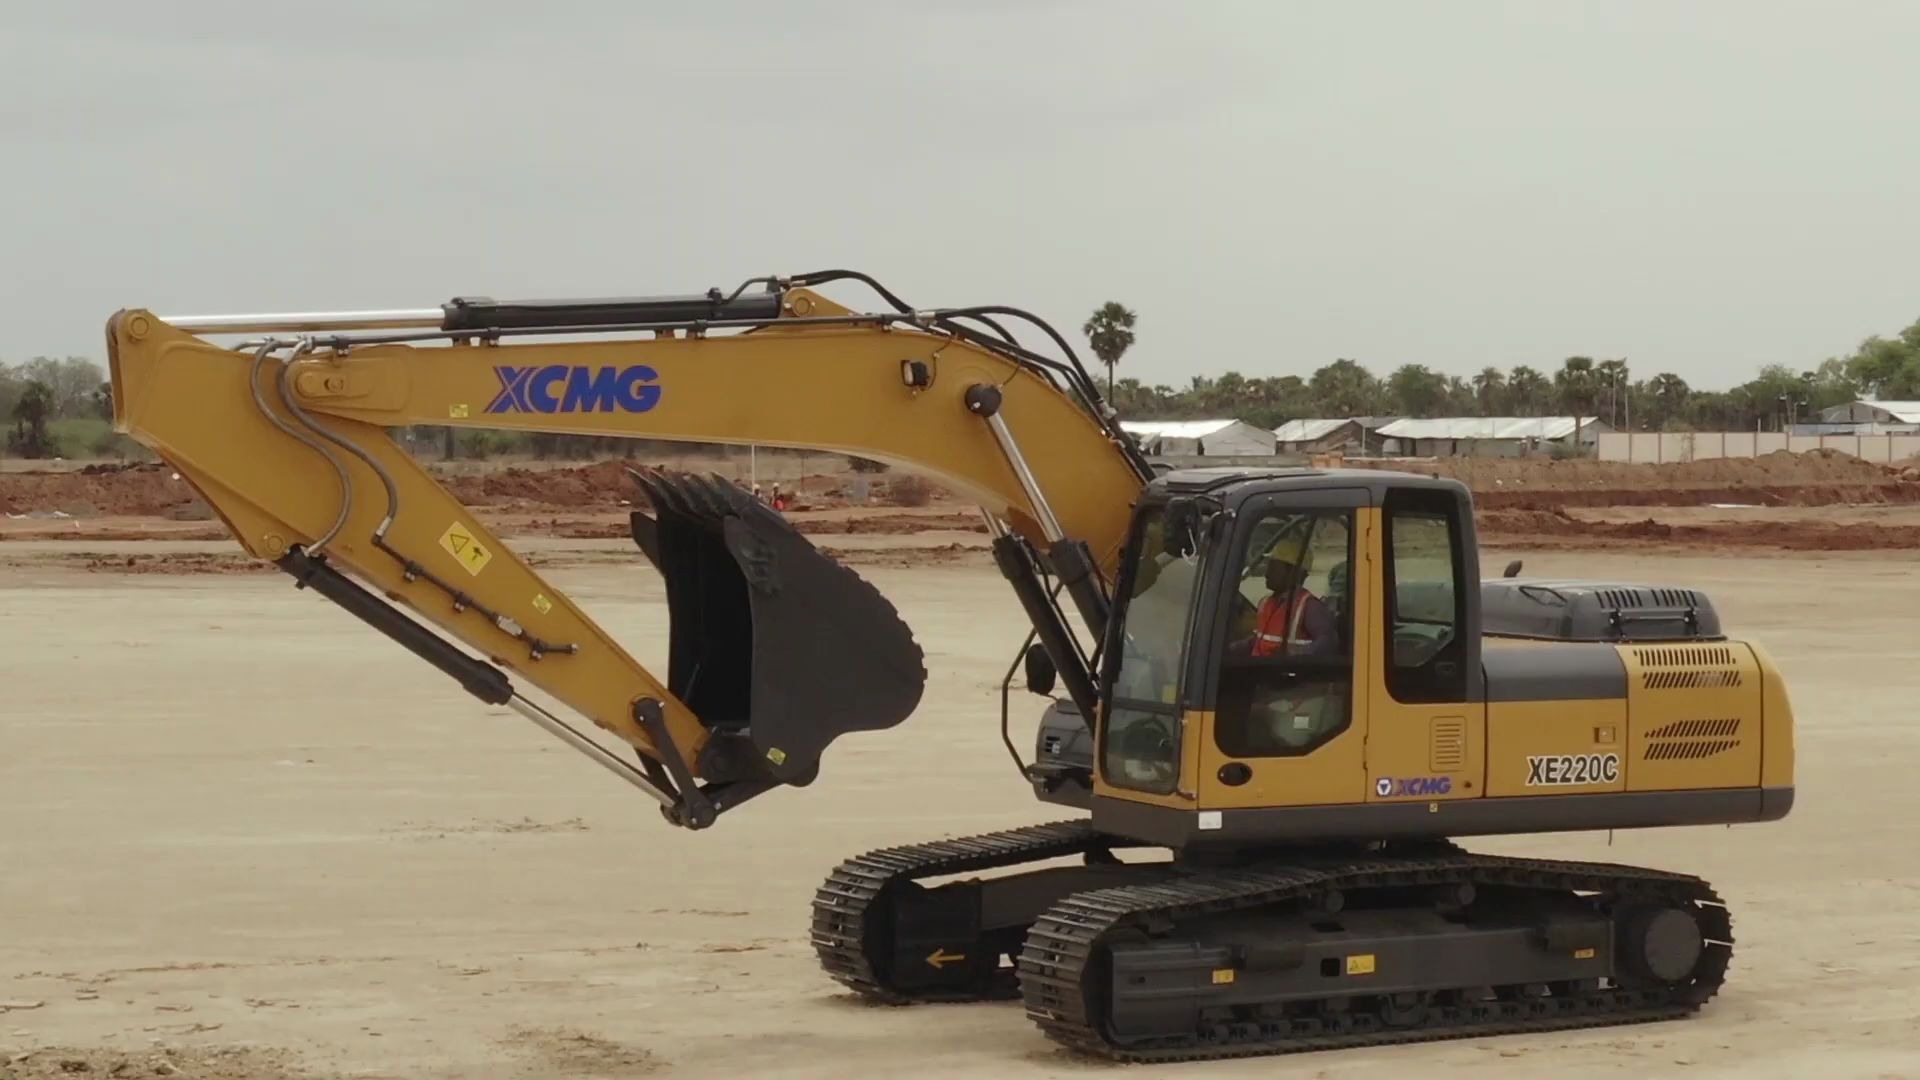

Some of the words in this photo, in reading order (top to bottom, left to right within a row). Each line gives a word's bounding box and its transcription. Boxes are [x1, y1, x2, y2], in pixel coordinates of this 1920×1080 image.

[482, 365, 662, 413] XCMG
[1526, 754, 1619, 785] XE220C
[1396, 777, 1451, 796] XCMG
